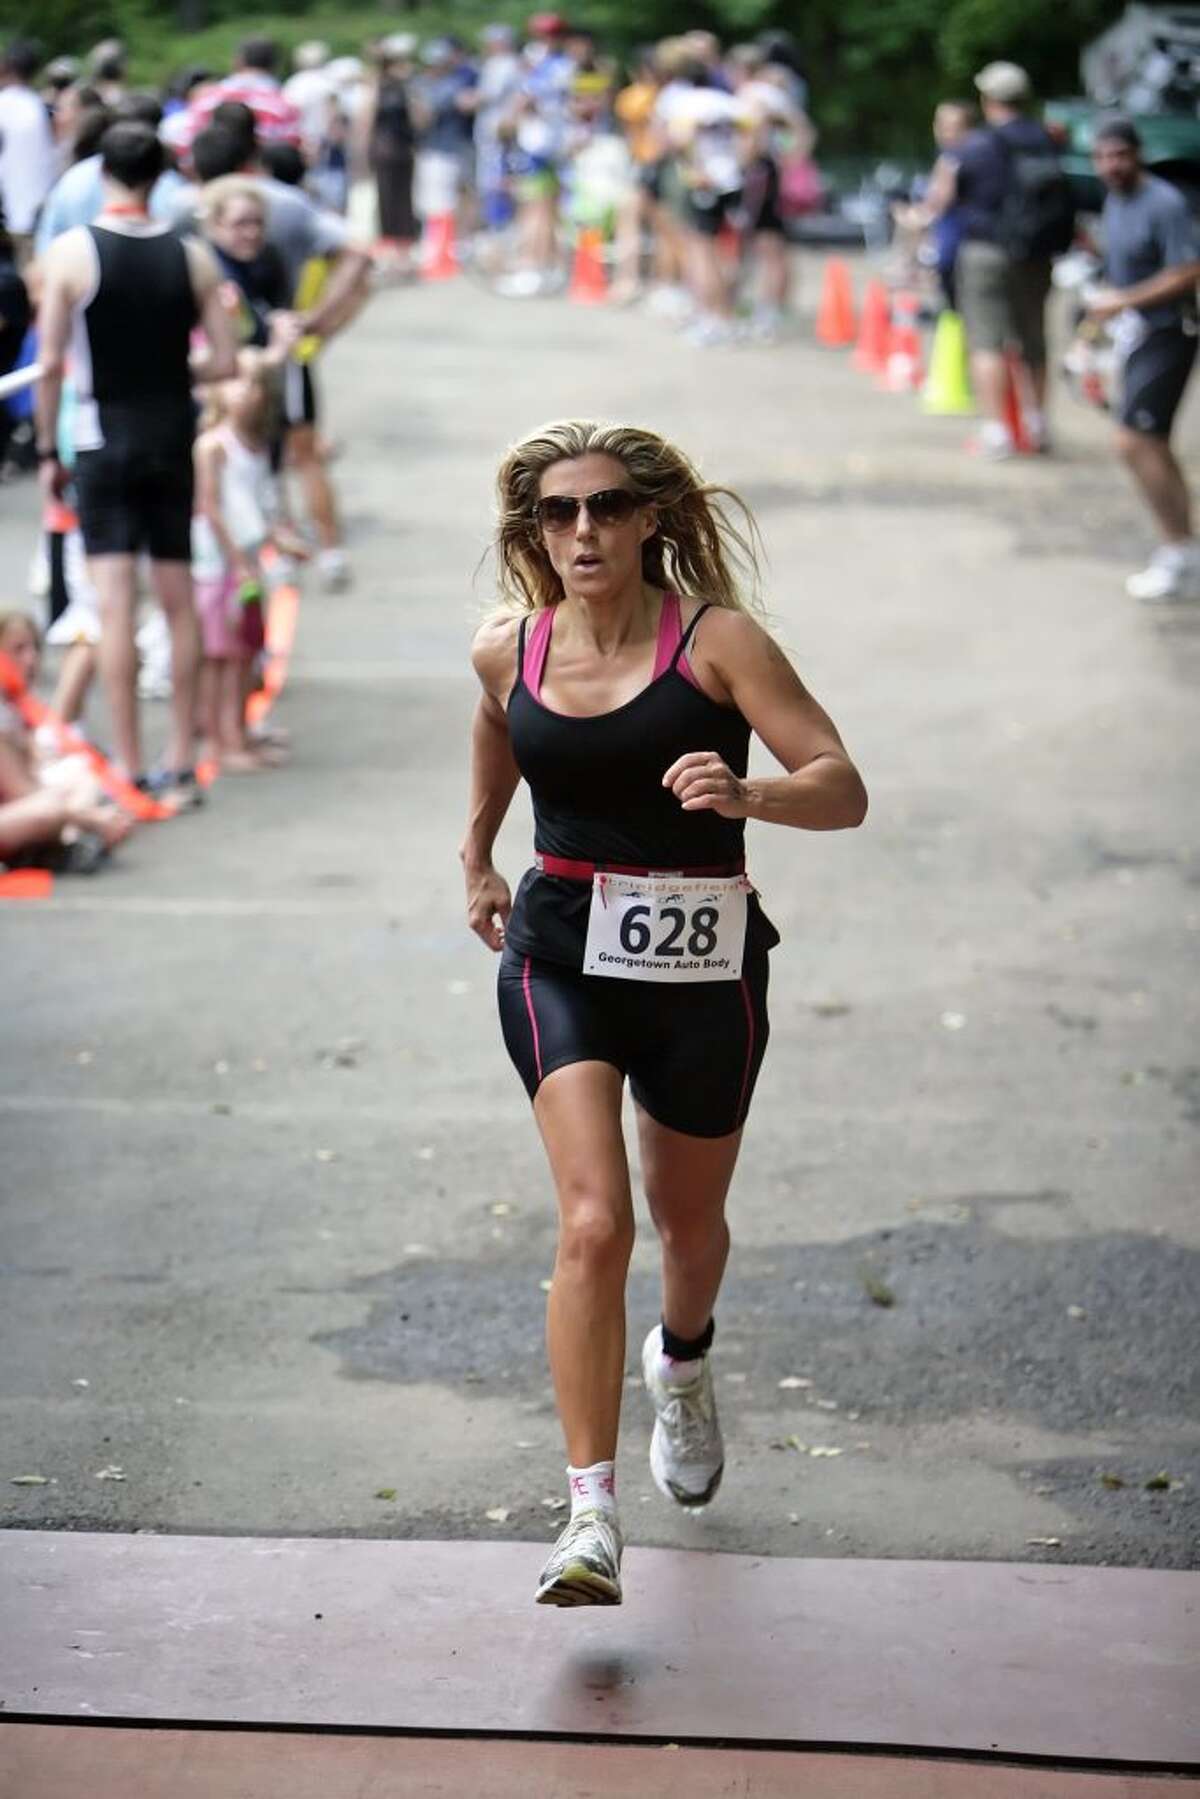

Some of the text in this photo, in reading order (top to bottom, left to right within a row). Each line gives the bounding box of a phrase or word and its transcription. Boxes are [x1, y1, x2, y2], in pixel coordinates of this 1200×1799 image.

[619, 905, 719, 956] 628
[599, 951, 731, 970] Georgetown Auto Body
